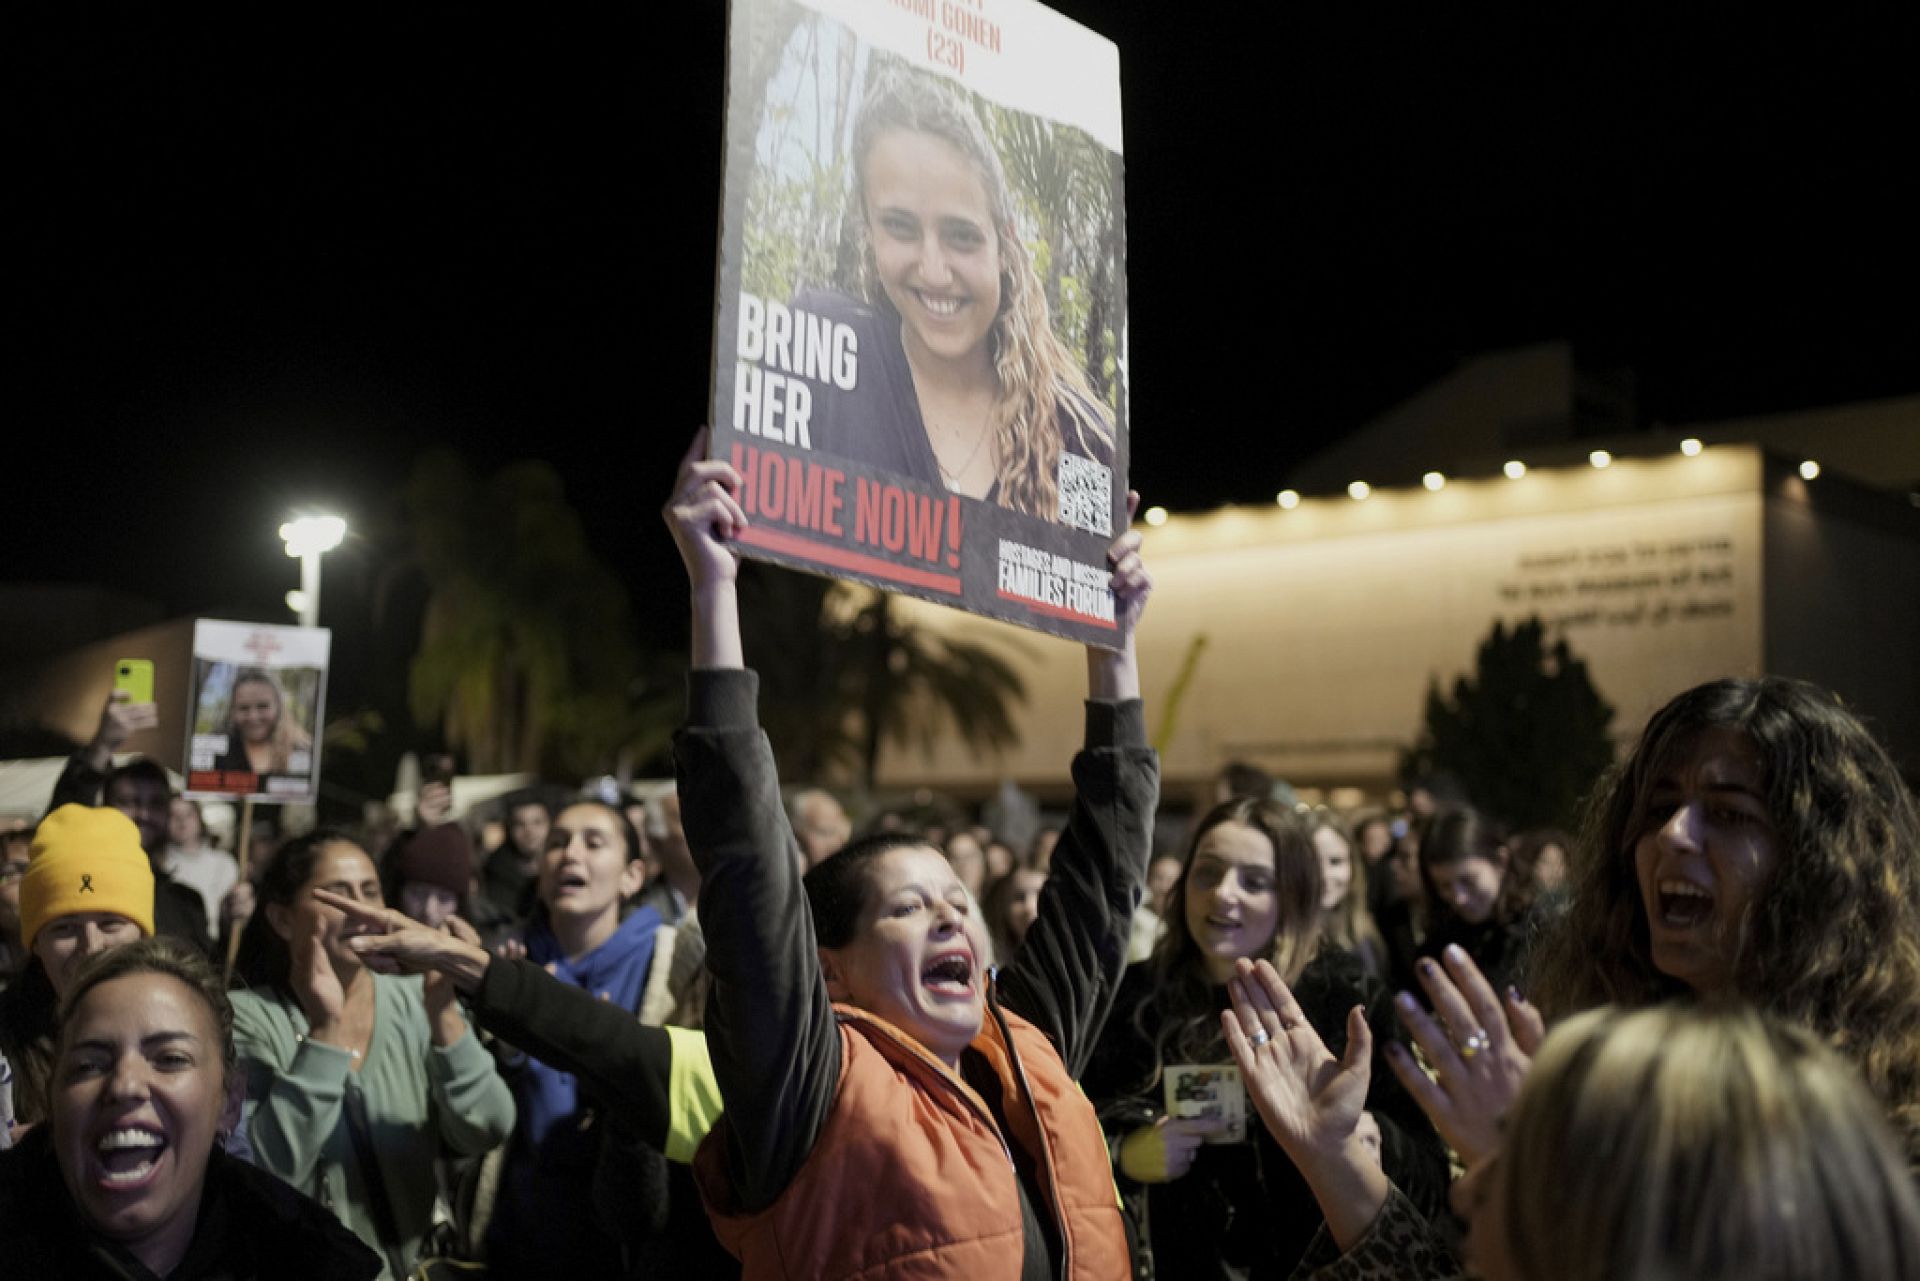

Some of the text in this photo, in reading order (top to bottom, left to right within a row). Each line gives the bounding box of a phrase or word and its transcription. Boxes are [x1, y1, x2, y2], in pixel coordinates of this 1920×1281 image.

[927, 26, 965, 75] (23)
[942, 1, 1001, 54] GONEN
[736, 291, 858, 391] BRING
[733, 361, 812, 450] HER
[731, 442, 960, 568] HOME NOW!
[999, 558, 1115, 622] FAMILIES FORUM
